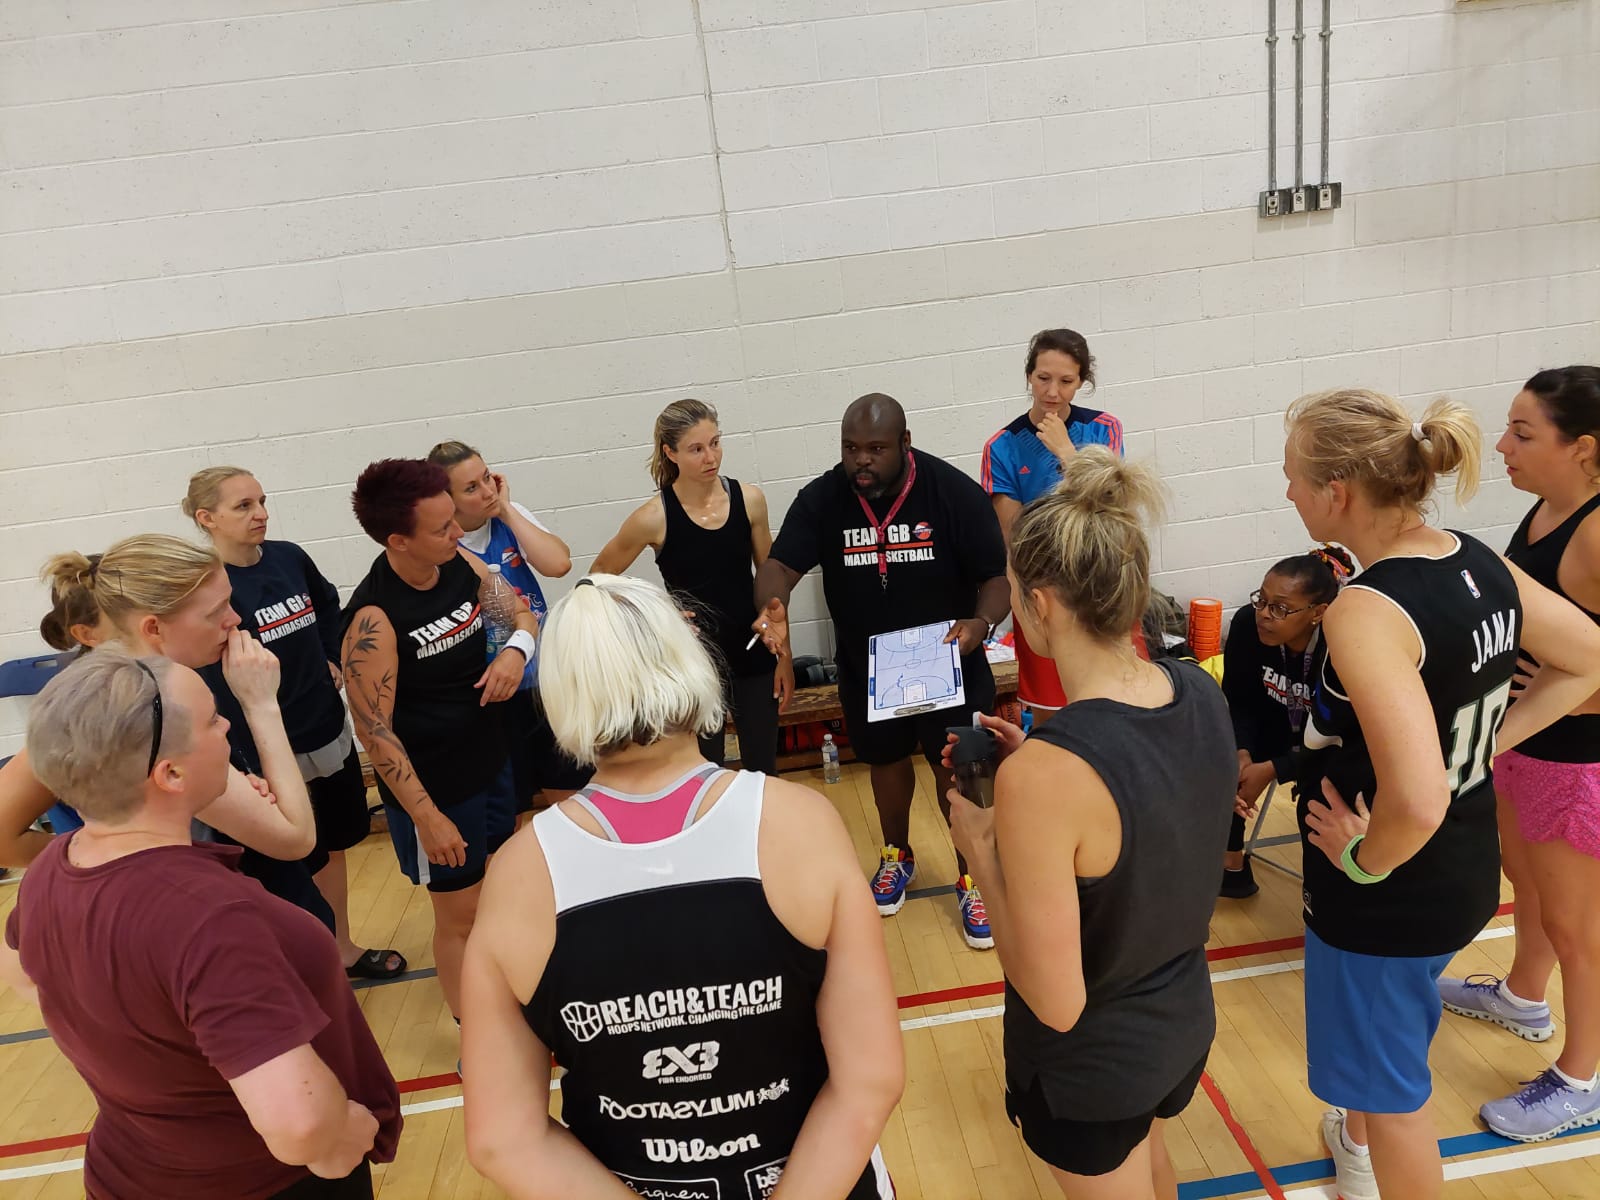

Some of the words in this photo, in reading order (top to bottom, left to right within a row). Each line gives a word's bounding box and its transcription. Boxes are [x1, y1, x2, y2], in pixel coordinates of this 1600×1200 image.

[887, 523, 911, 544] GB
[843, 547, 935, 567] MAXIBSKETBALL
[254, 601, 290, 627] TEAM
[259, 611, 317, 644] MAXIBASKETB
[408, 616, 459, 647] TEAM
[416, 613, 483, 660] MAXIBASKETB
[1471, 608, 1516, 674] JANA
[599, 975, 783, 1026] REACH&TEACH
[606, 1021, 640, 1035] HOOPS
[688, 1009, 739, 1025] CHANGING
[738, 1005, 756, 1018] THE
[755, 999, 783, 1015] GAME
[675, 1073, 712, 1084] ENDORSED
[598, 1090, 756, 1120] FOOTASYLUM
[641, 1133, 761, 1164] Wilson
